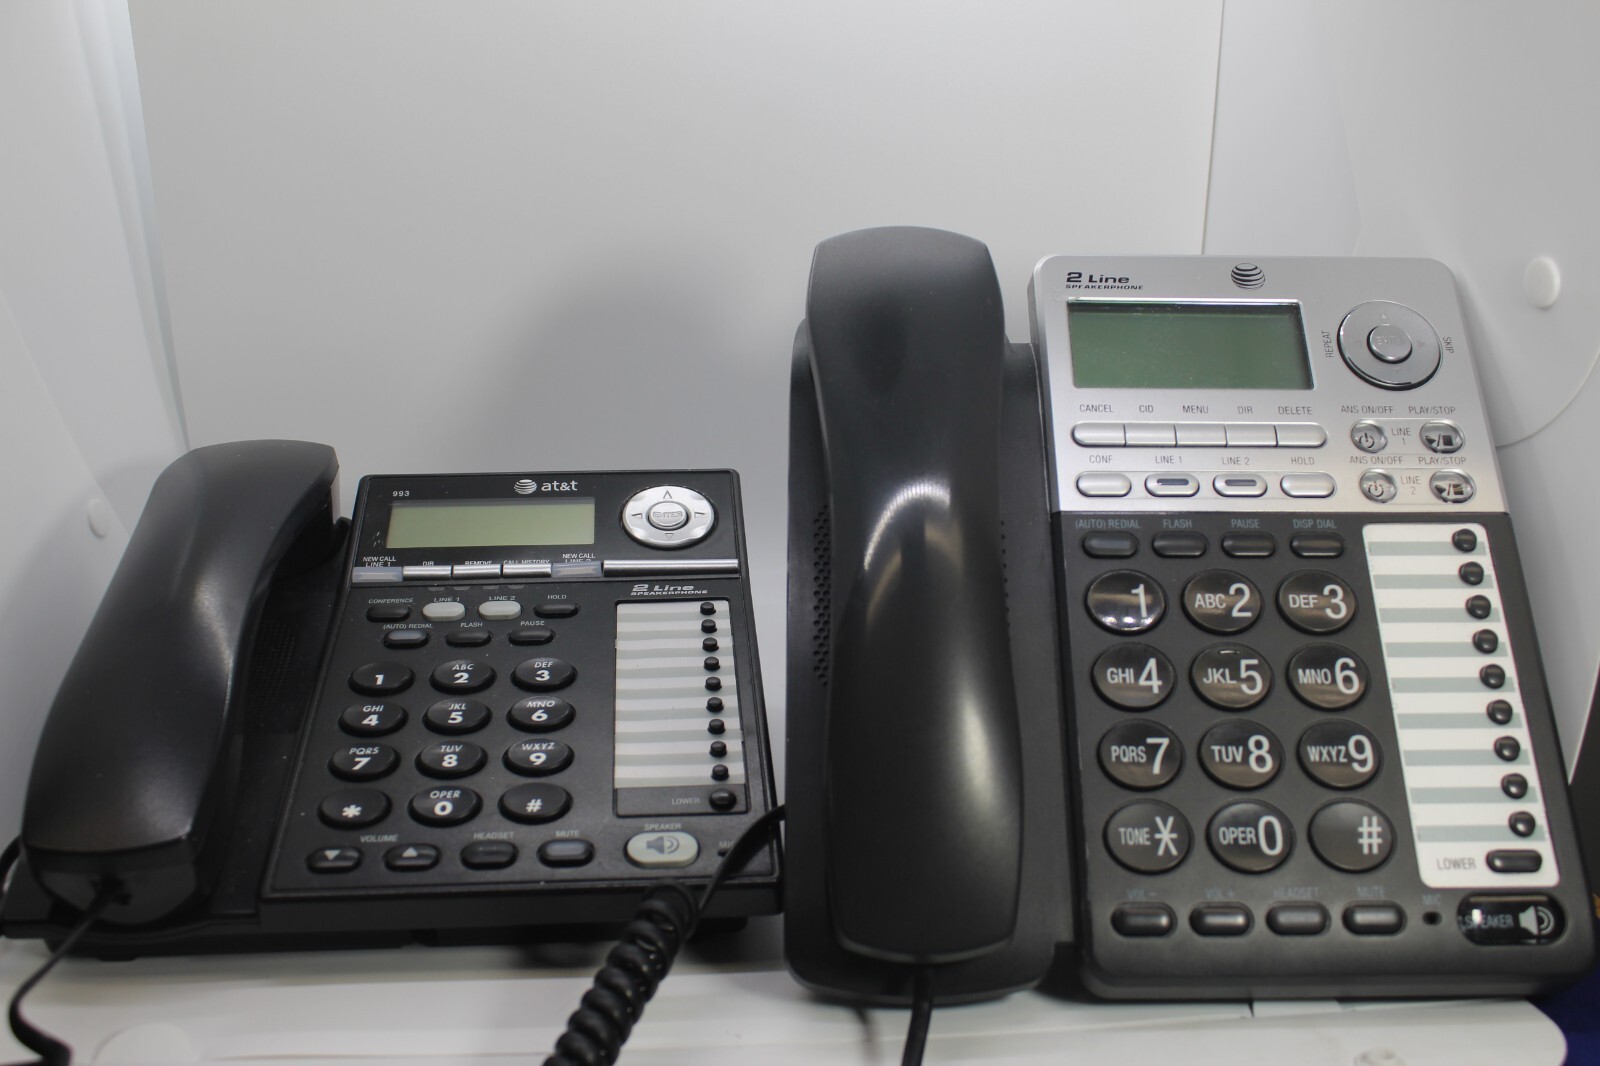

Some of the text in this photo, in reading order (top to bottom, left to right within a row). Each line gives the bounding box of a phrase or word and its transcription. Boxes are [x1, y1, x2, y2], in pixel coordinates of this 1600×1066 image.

[1066, 272, 1130, 284] 2 Line
[1321, 330, 1333, 358] REPEAT
[1443, 336, 1455, 354] SKIP
[1079, 404, 1114, 413] CANCEL
[1138, 404, 1154, 413] CID
[1182, 405, 1209, 414] MENU
[1237, 405, 1253, 414] DIR
[1278, 406, 1312, 415] DELETE
[1341, 405, 1394, 414] ANS ON/OFF
[1408, 406, 1456, 414] PLAY/STOP
[1391, 428, 1412, 436] LINE
[1089, 455, 1113, 464] CONF
[1155, 456, 1182, 464] LINE 1
[1221, 457, 1250, 465] LINE 2
[1291, 457, 1315, 465] HOLD
[1350, 456, 1404, 464] ANS ON/OFF
[1418, 457, 1467, 465] PLAY/STOP
[541, 480, 578, 491] at&t
[1400, 476, 1421, 485] LINE
[1410, 486, 1416, 494] 2
[1075, 518, 1141, 529] (AUTO) REDIAL
[1163, 518, 1193, 528] FLASH
[1231, 518, 1260, 528] PAUSE
[1293, 519, 1337, 528] DISP DIAL
[1131, 583, 1148, 618] 1
[1194, 583, 1252, 617] ABC 2
[1288, 584, 1347, 619] DEF 3
[452, 663, 474, 671] ABC
[374, 674, 384, 685] 1
[453, 672, 469, 684] 2
[535, 670, 550, 681] 3
[1107, 658, 1163, 694] GHI 4
[1203, 659, 1263, 695] JKL 5
[1298, 658, 1359, 695] MNO 6
[448, 702, 467, 710] JKL
[526, 700, 555, 708] MNO
[362, 714, 379, 726] 4
[448, 711, 463, 723] 5
[531, 710, 548, 722] 6
[349, 747, 379, 755] PQRS
[521, 742, 555, 750] WXYZ
[529, 752, 547, 766] 9
[1111, 737, 1170, 775] PQRS 7
[1211, 734, 1273, 773] TUV 8
[1307, 734, 1374, 773] WXYZ 9
[352, 757, 371, 770] 7
[441, 754, 458, 768] 8
[430, 790, 461, 799] OPER
[434, 801, 453, 816] 0
[644, 823, 682, 831] SPEAKER
[360, 834, 399, 843] VOLUME
[473, 831, 515, 840] HEADSET
[555, 829, 580, 838] MUTE
[1118, 828, 1151, 845] TONE
[1218, 815, 1283, 855] OPER 0
[1436, 857, 1476, 870] LOWER
[1272, 887, 1319, 898] HEADSET
[1356, 886, 1385, 897] MUTE
[1422, 893, 1441, 905] MIC
[1464, 913, 1515, 929] SEAKER
